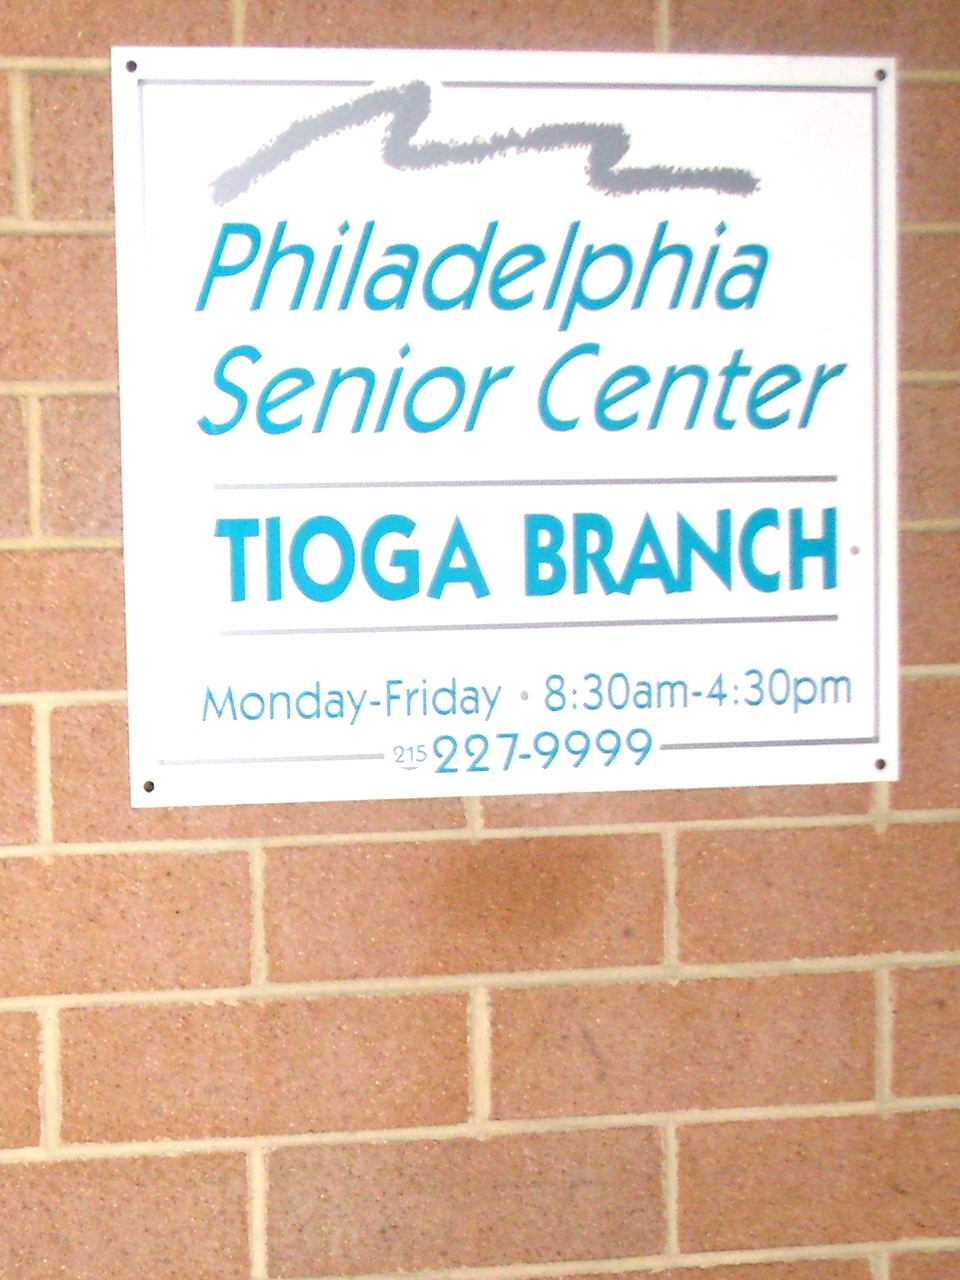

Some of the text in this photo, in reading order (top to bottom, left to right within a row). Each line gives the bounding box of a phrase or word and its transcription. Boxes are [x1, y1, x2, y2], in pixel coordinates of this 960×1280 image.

[194, 220, 770, 331] Philadelphia
[196, 342, 848, 436] Senior Center
[214, 507, 839, 602] TIOGA BRANCH
[202, 668, 852, 725] Monday-Friday 8:30am-4:30pm
[393, 728, 653, 774] 215 227-9999
